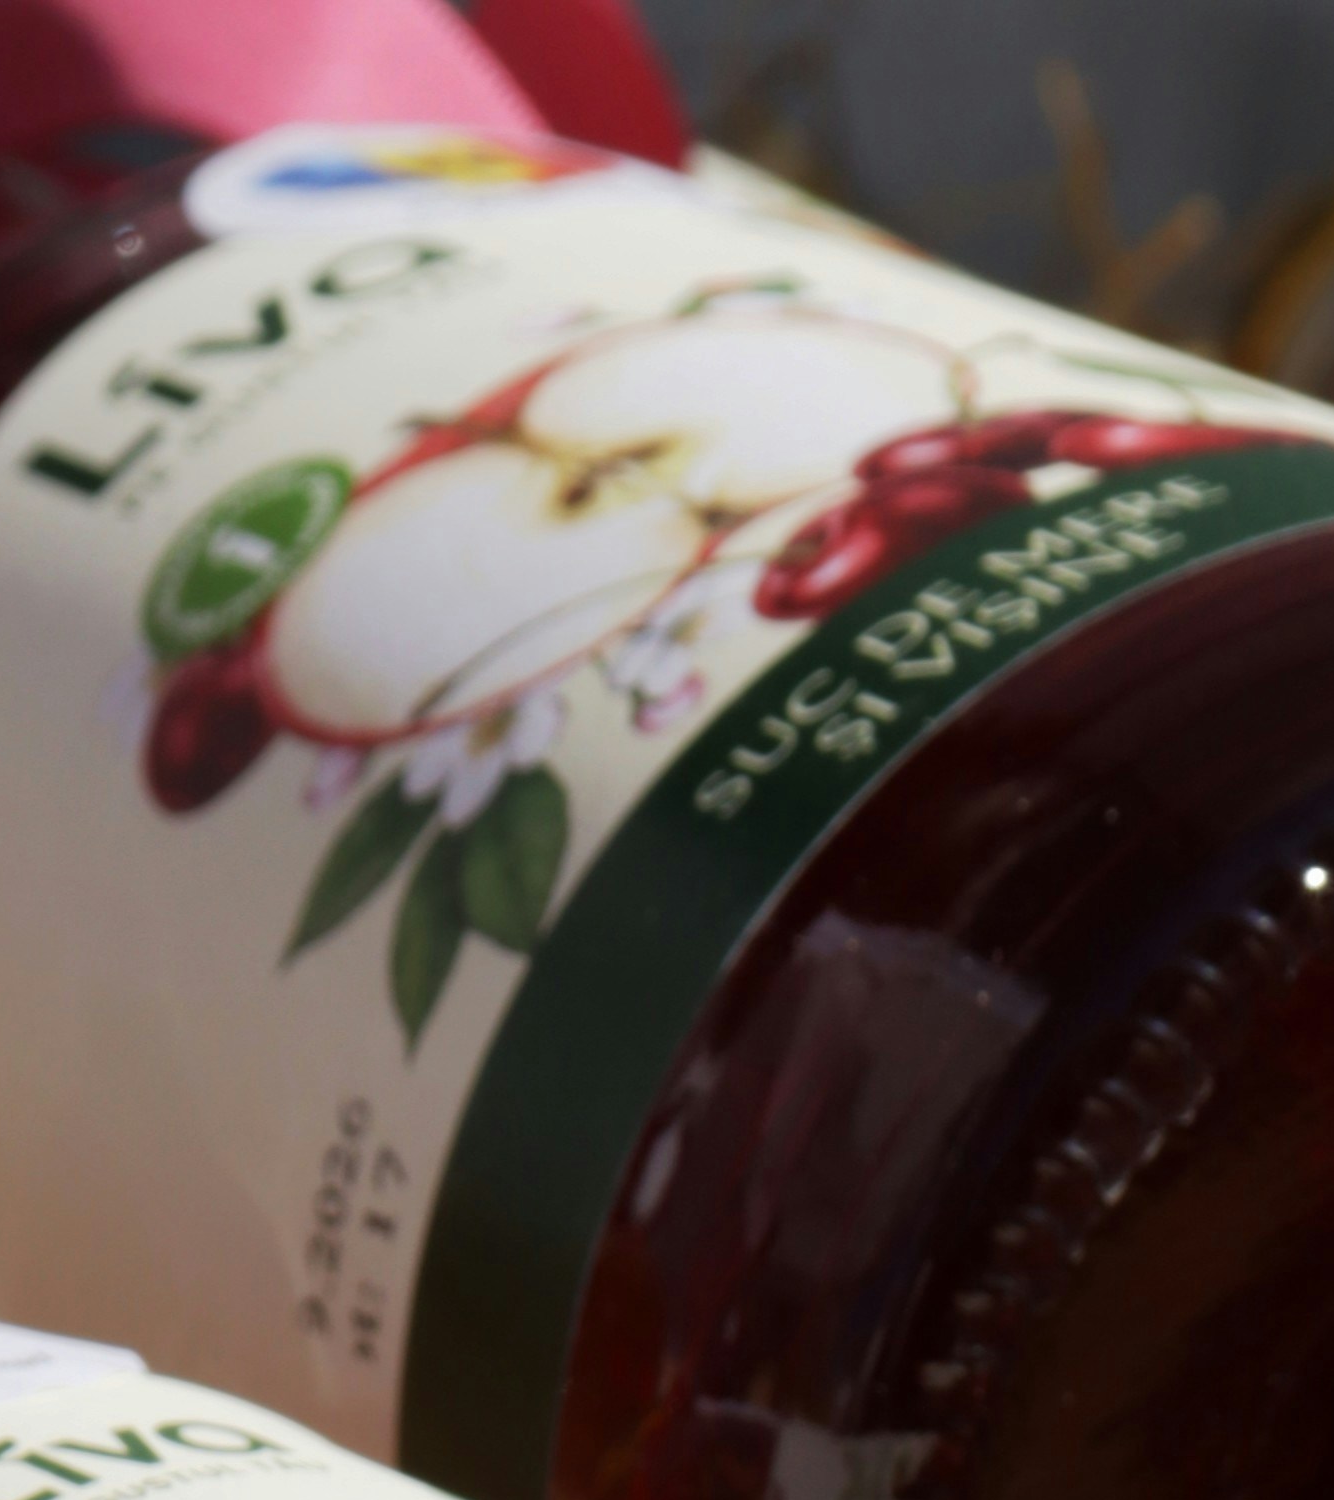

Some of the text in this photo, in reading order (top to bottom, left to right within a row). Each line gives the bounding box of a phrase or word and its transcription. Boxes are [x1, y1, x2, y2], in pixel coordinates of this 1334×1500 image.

[693, 473, 1230, 820] SUC DE MERE
